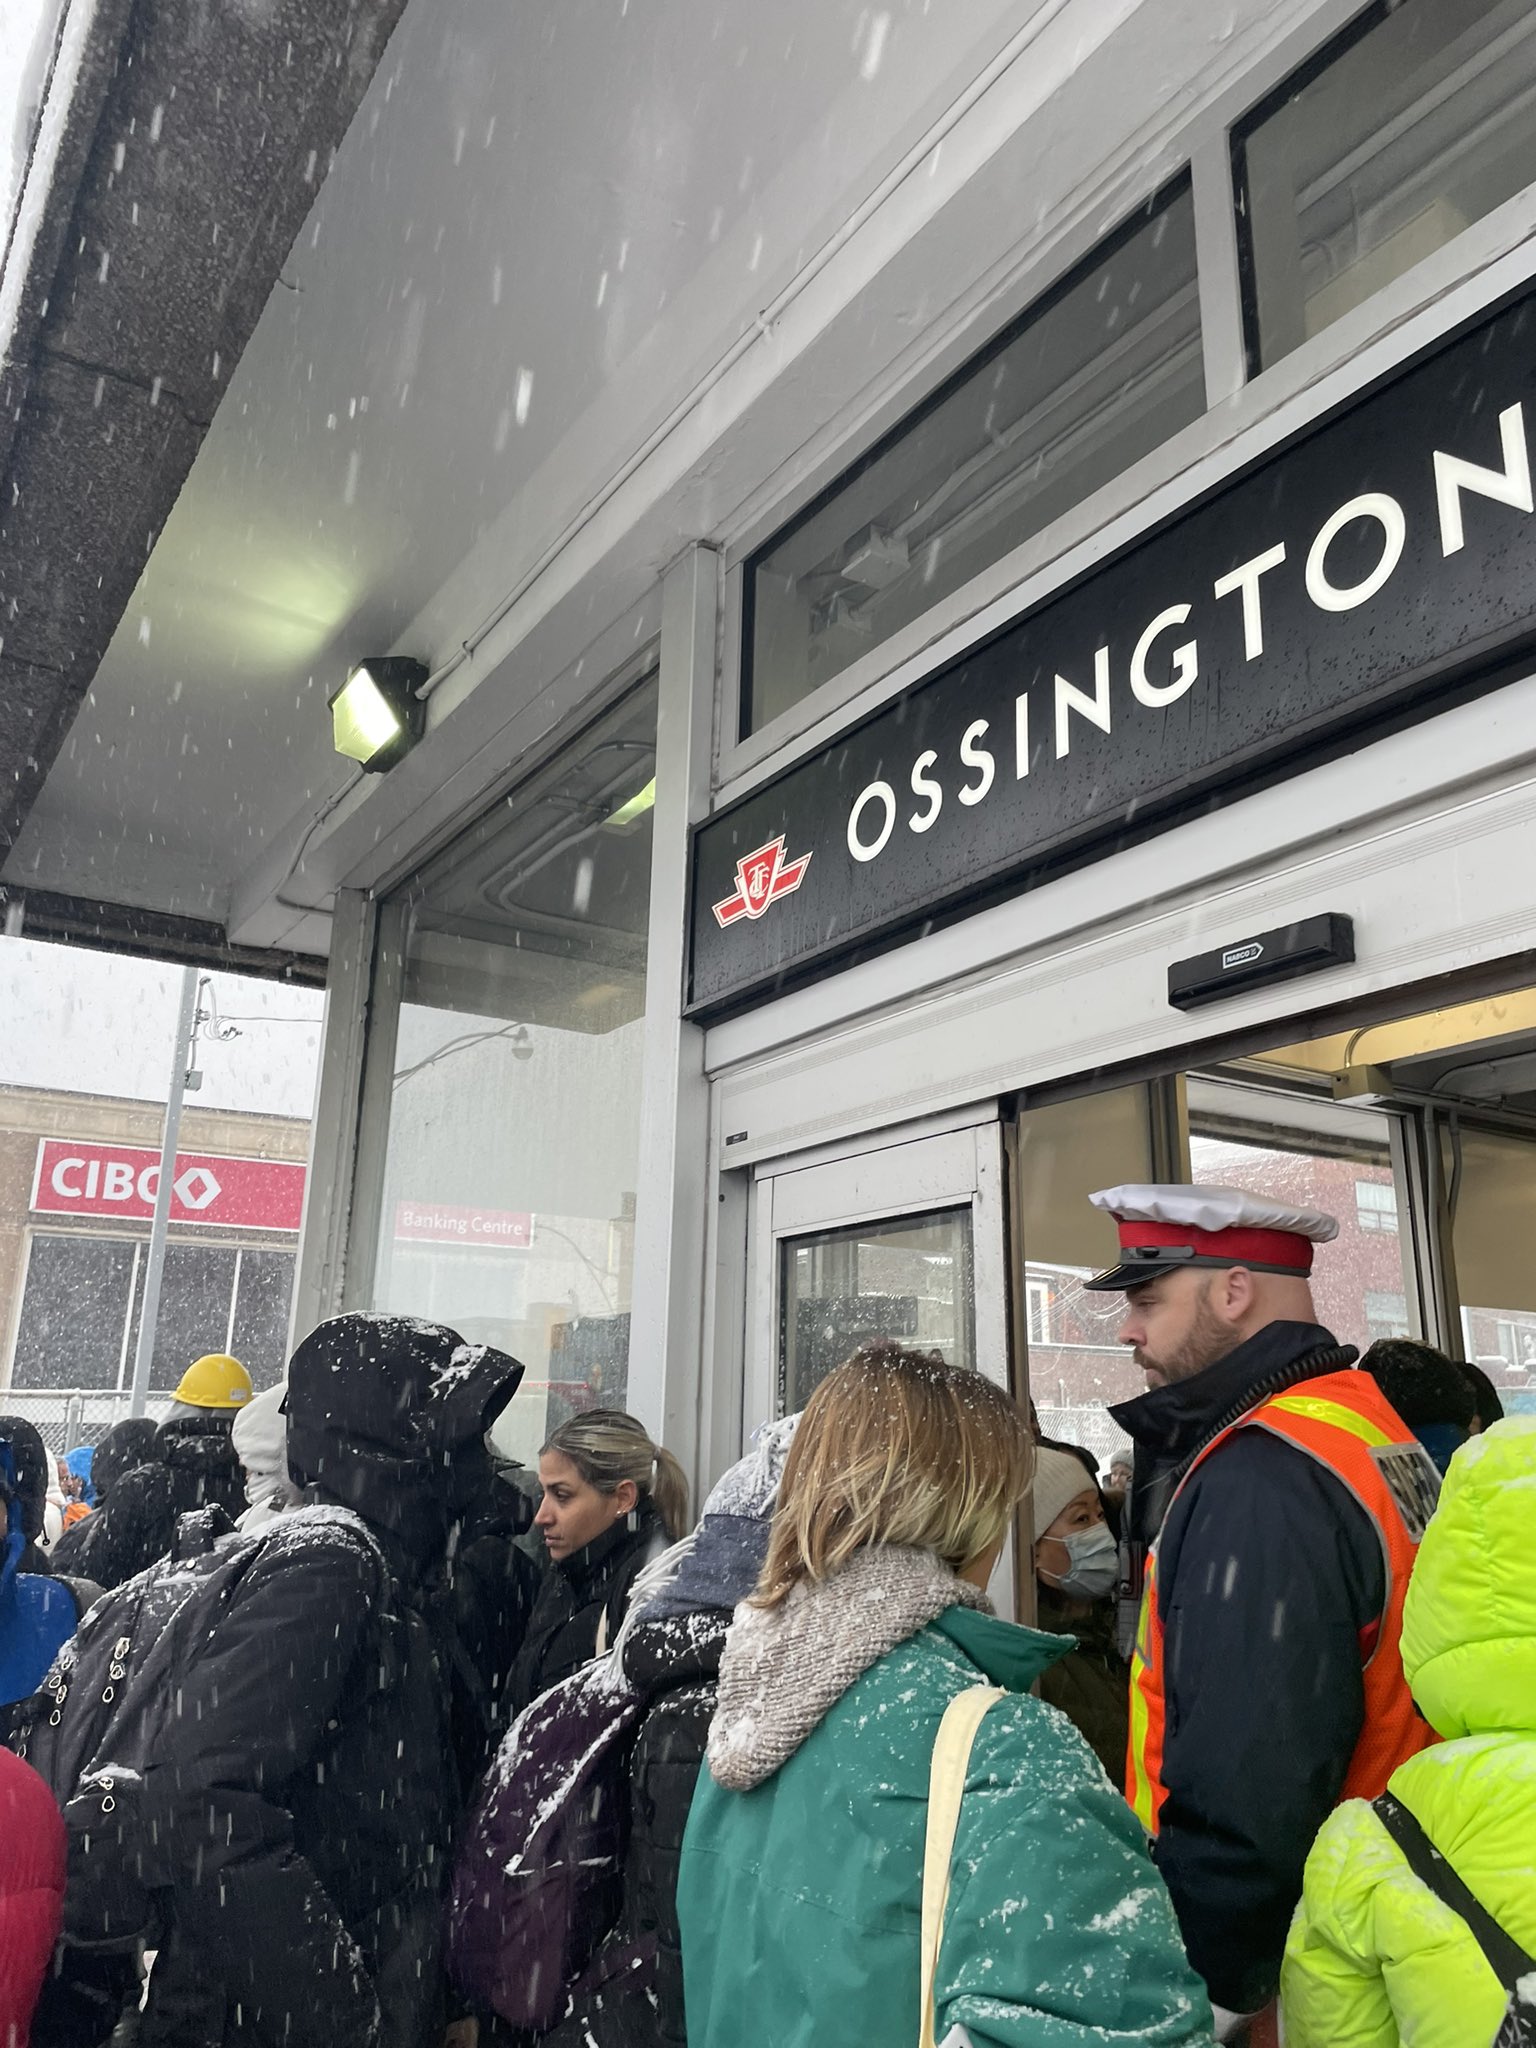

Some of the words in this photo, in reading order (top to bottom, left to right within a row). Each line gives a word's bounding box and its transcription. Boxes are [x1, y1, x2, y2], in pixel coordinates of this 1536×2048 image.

[847, 402, 1534, 862] OSSINGTON
[402, 1210, 467, 1235] Banking
[471, 1216, 523, 1236] Centre
